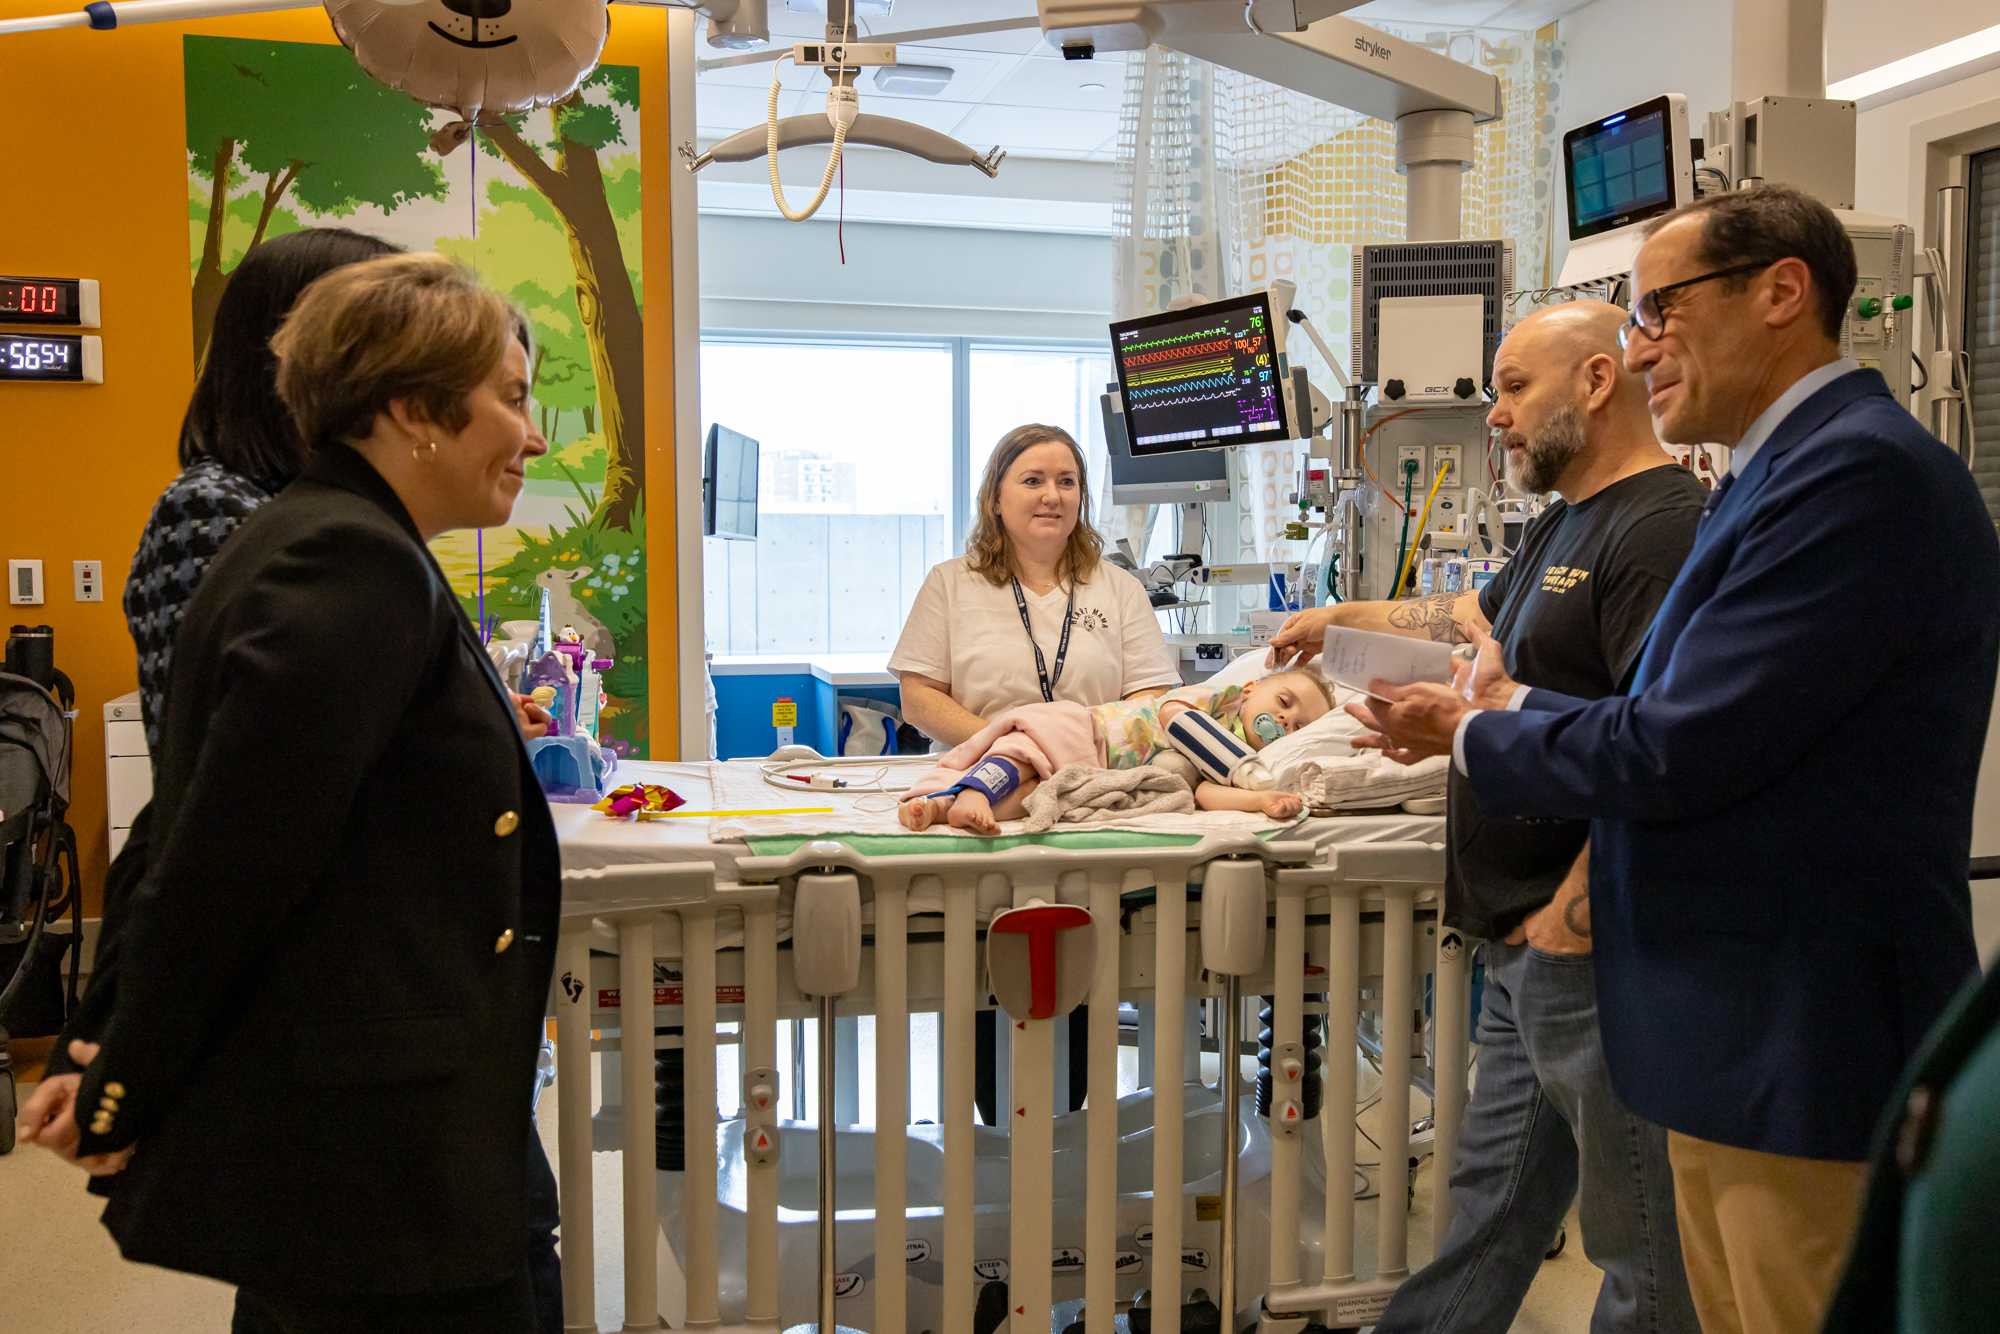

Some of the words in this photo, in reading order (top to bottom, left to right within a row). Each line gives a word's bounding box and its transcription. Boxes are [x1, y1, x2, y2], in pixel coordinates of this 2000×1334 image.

[1354, 36, 1392, 60] stryker
[1249, 317, 1262, 329] 76
[1252, 336, 1261, 347] 57
[1258, 370, 1269, 382] 97
[1260, 386, 1271, 398] 31
[1092, 607, 1109, 629] MAMA
